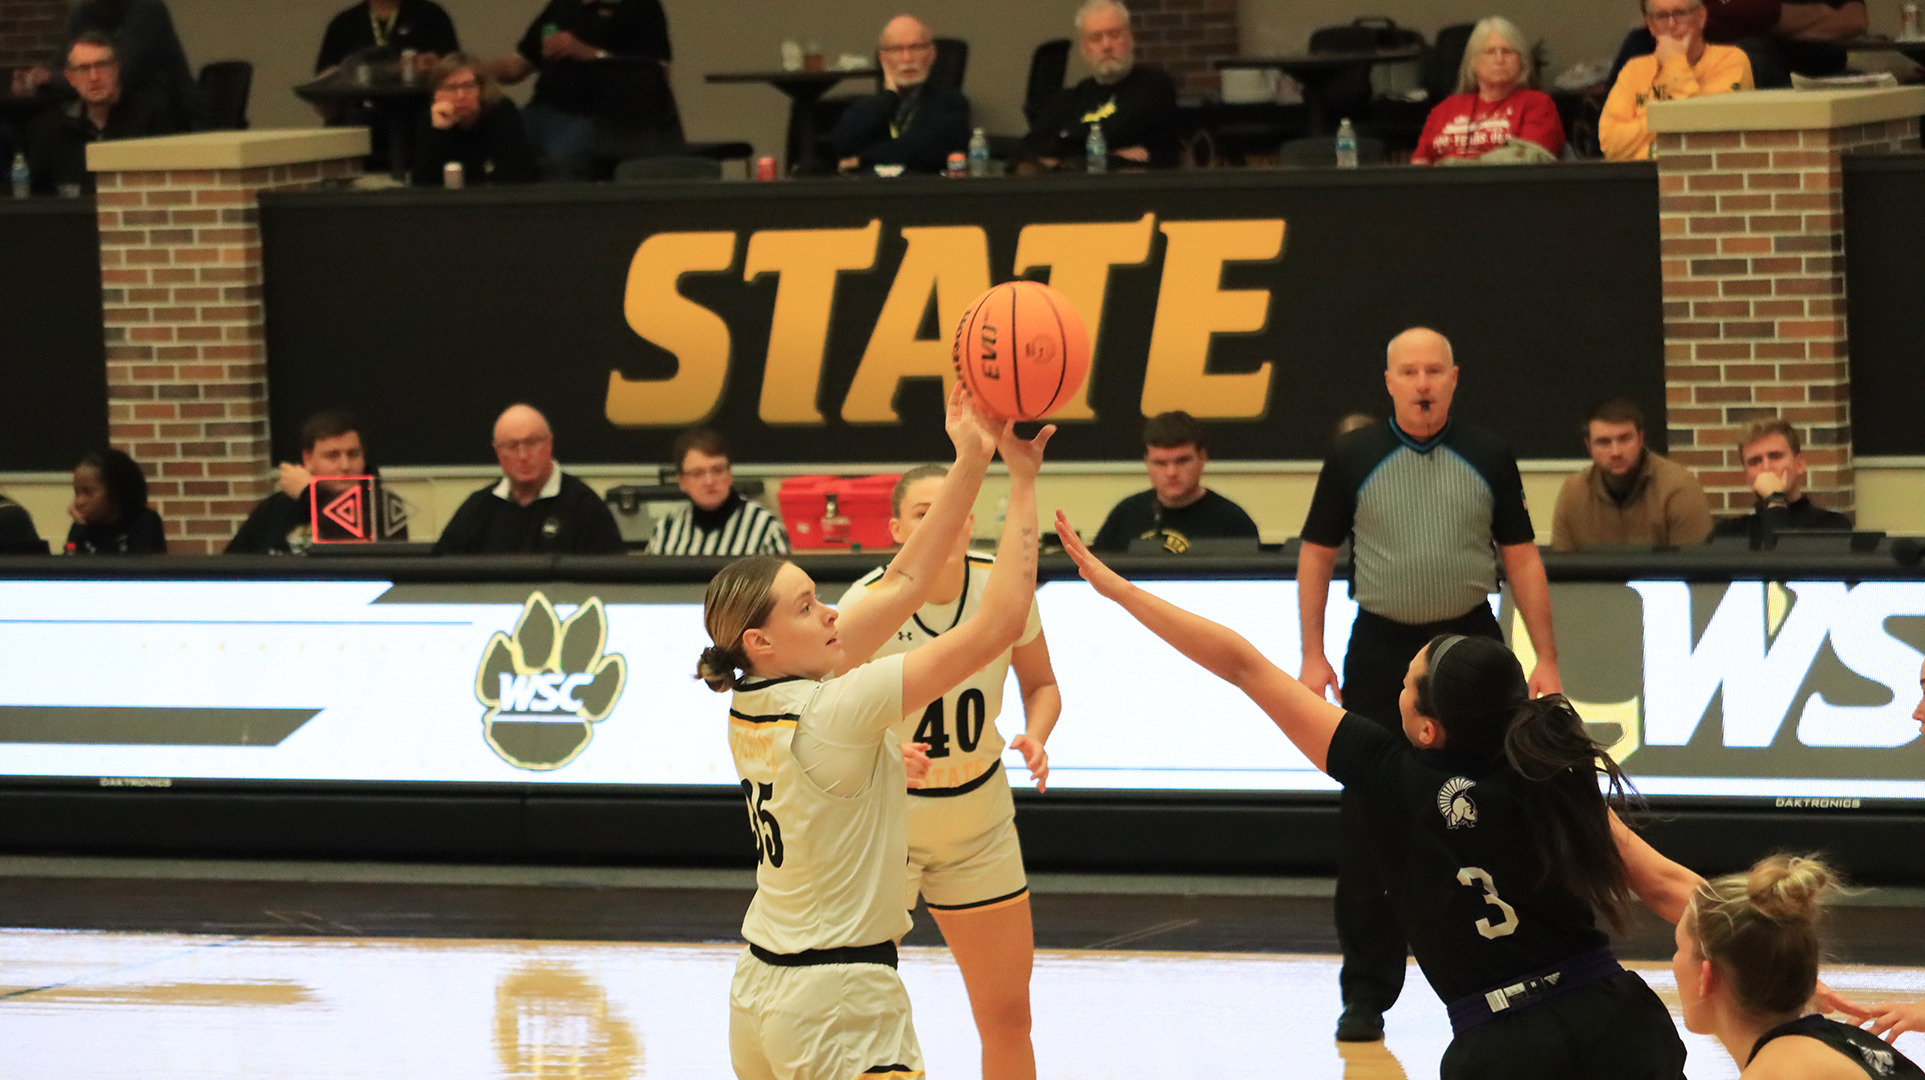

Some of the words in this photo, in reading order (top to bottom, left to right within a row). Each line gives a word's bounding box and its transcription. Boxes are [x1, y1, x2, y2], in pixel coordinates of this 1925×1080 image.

[605, 211, 1286, 425] STATE
[499, 672, 595, 712] WSC
[912, 688, 985, 759] 40
[924, 758, 985, 788] TATE
[1775, 797, 1860, 808] DAKTRONICS
[1456, 866, 1520, 940] 3
